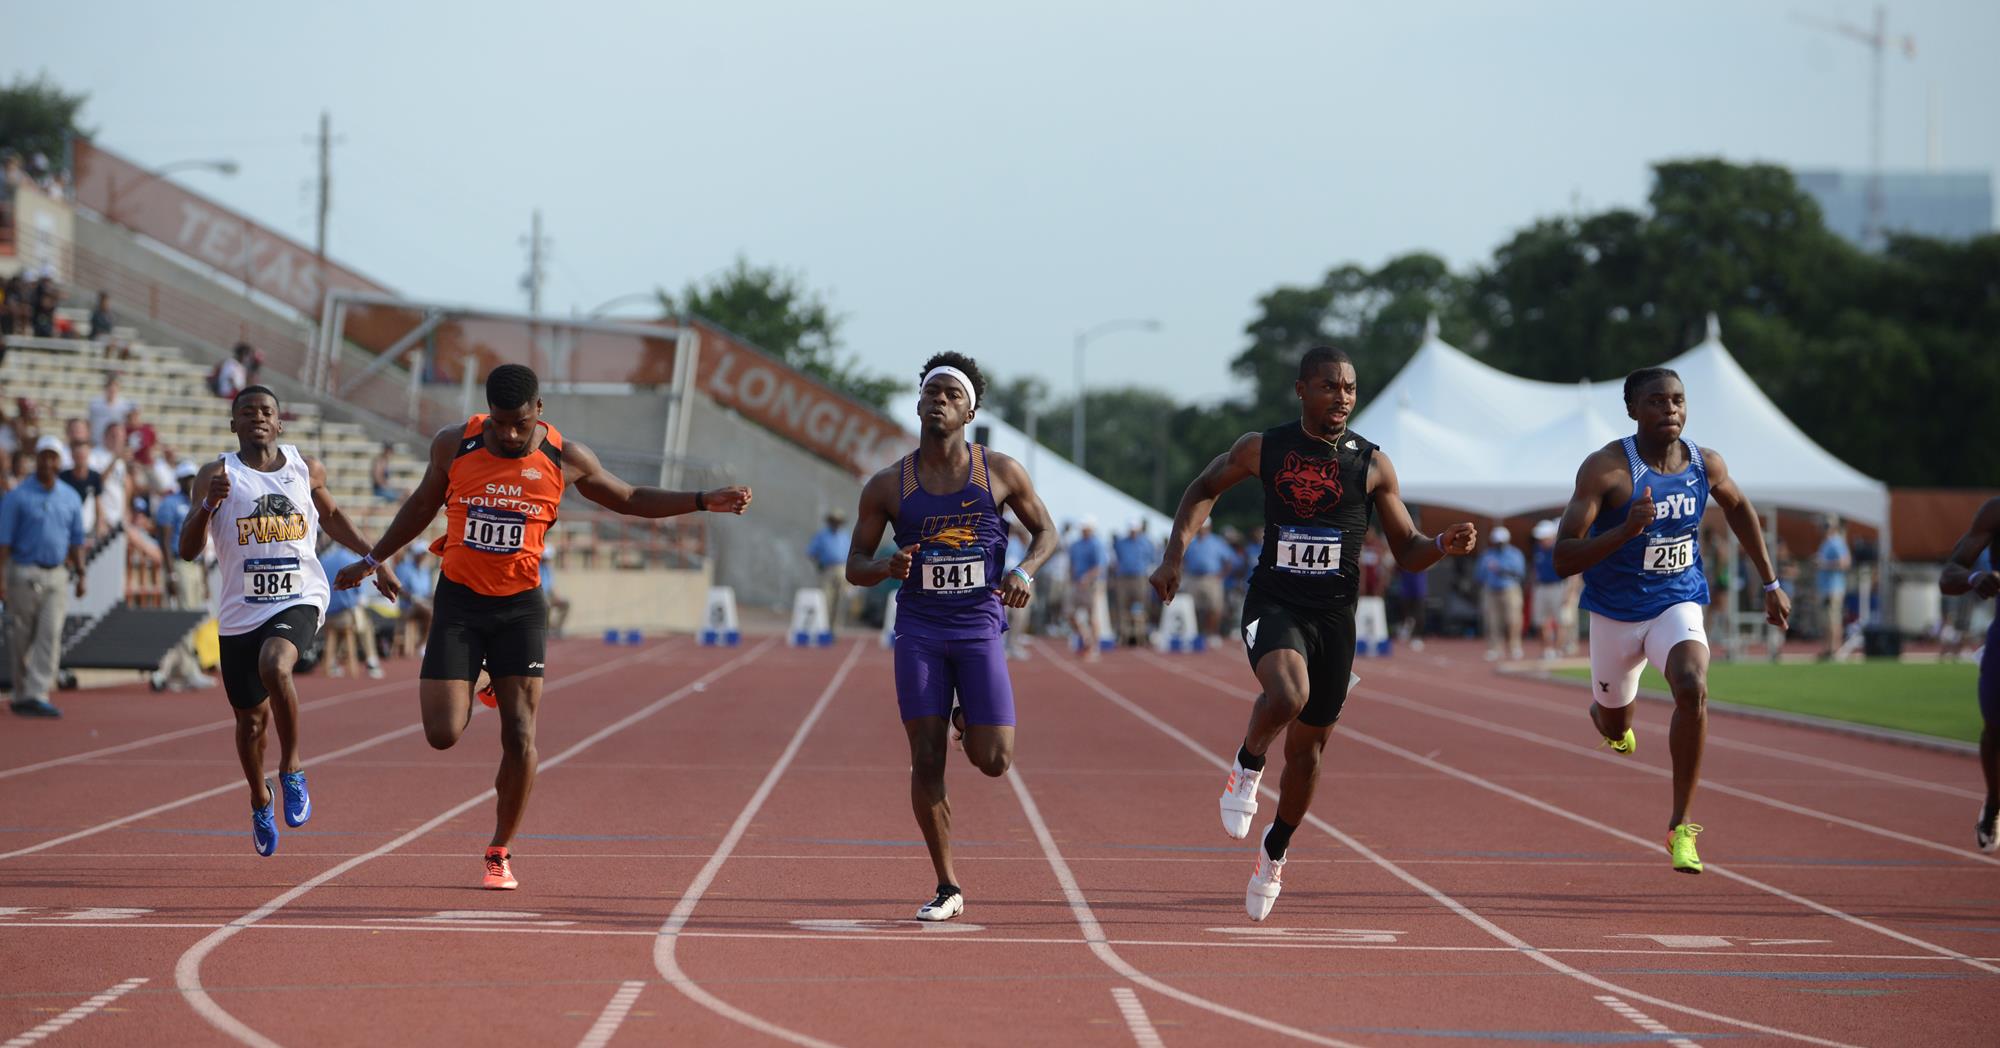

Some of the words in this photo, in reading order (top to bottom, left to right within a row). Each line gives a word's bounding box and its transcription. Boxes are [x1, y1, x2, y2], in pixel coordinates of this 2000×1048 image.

[177, 202, 323, 305] TEXAS
[485, 483, 522, 497] SAM
[459, 496, 543, 516] HOUSTON
[1655, 493, 1696, 519] BYU
[236, 512, 309, 546] PVAMU
[466, 520, 522, 547] 1019
[1287, 543, 1331, 568] 144
[1653, 543, 1687, 569] 256
[253, 572, 293, 595] 984
[932, 564, 975, 589] 841
